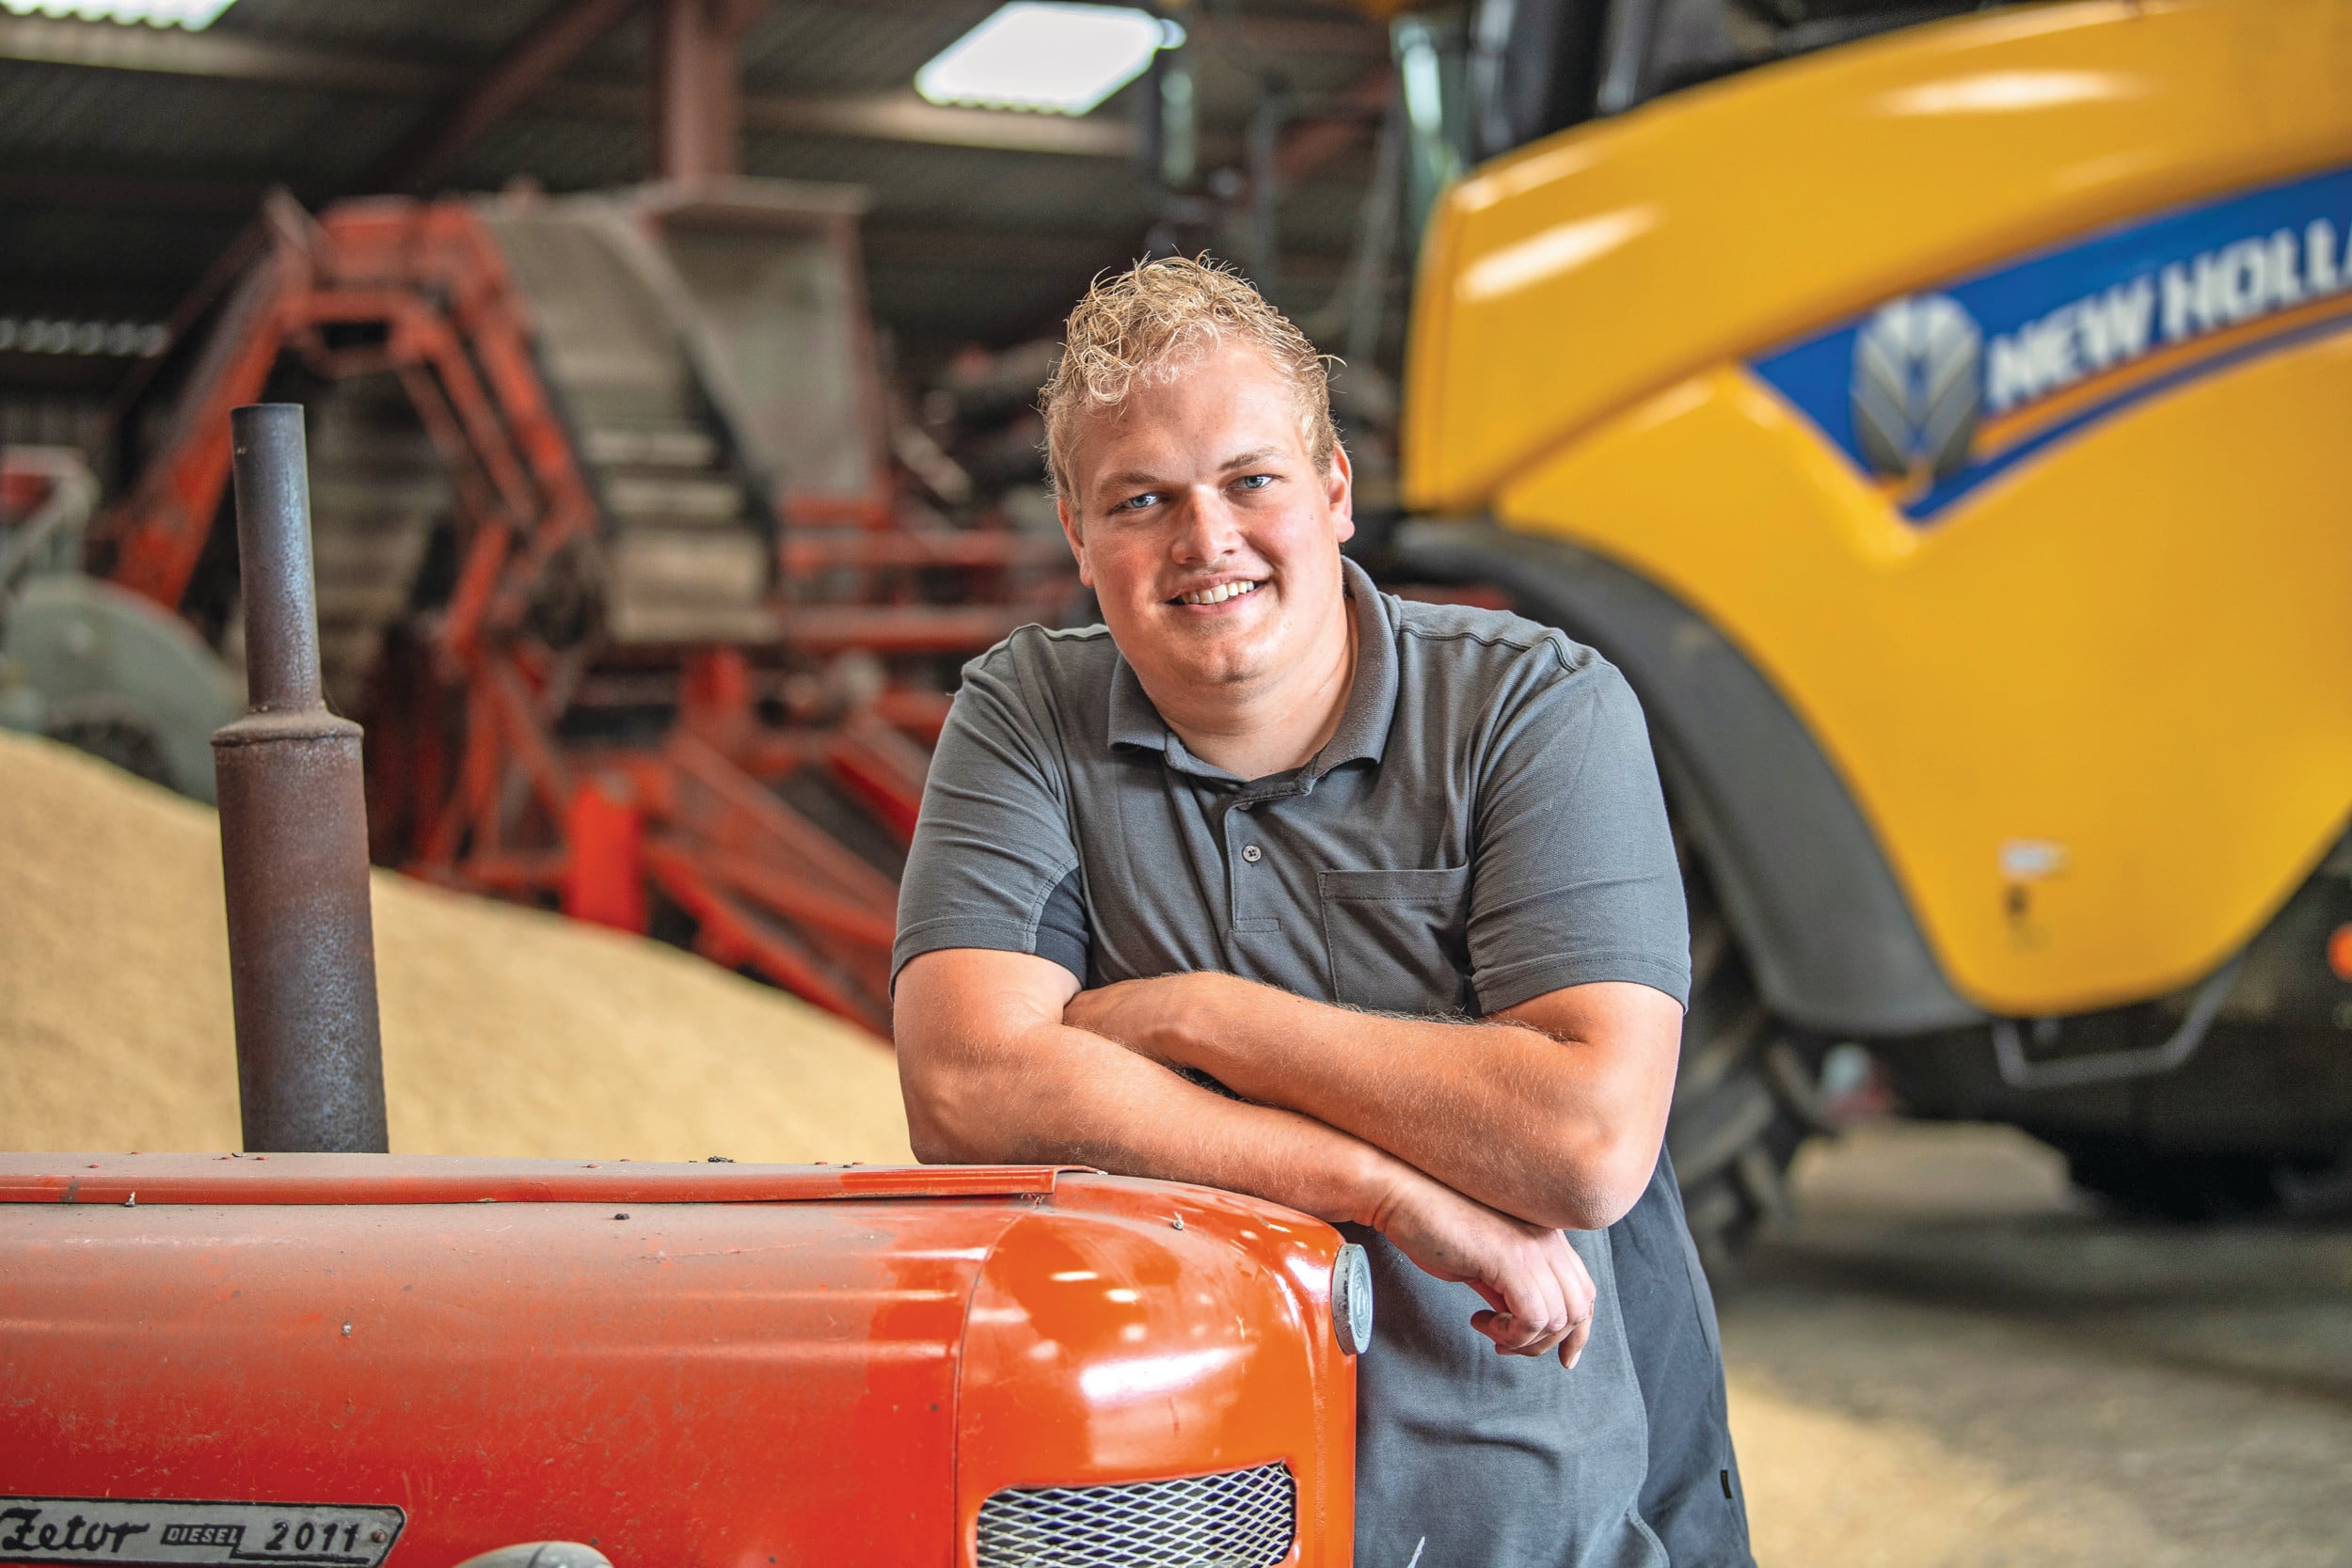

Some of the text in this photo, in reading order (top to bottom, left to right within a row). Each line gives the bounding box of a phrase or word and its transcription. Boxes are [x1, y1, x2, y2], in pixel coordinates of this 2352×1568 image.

[1987, 216, 2352, 410] NEW HOLL
[0, 1507, 360, 1553] Zetor DIESEL 2011
